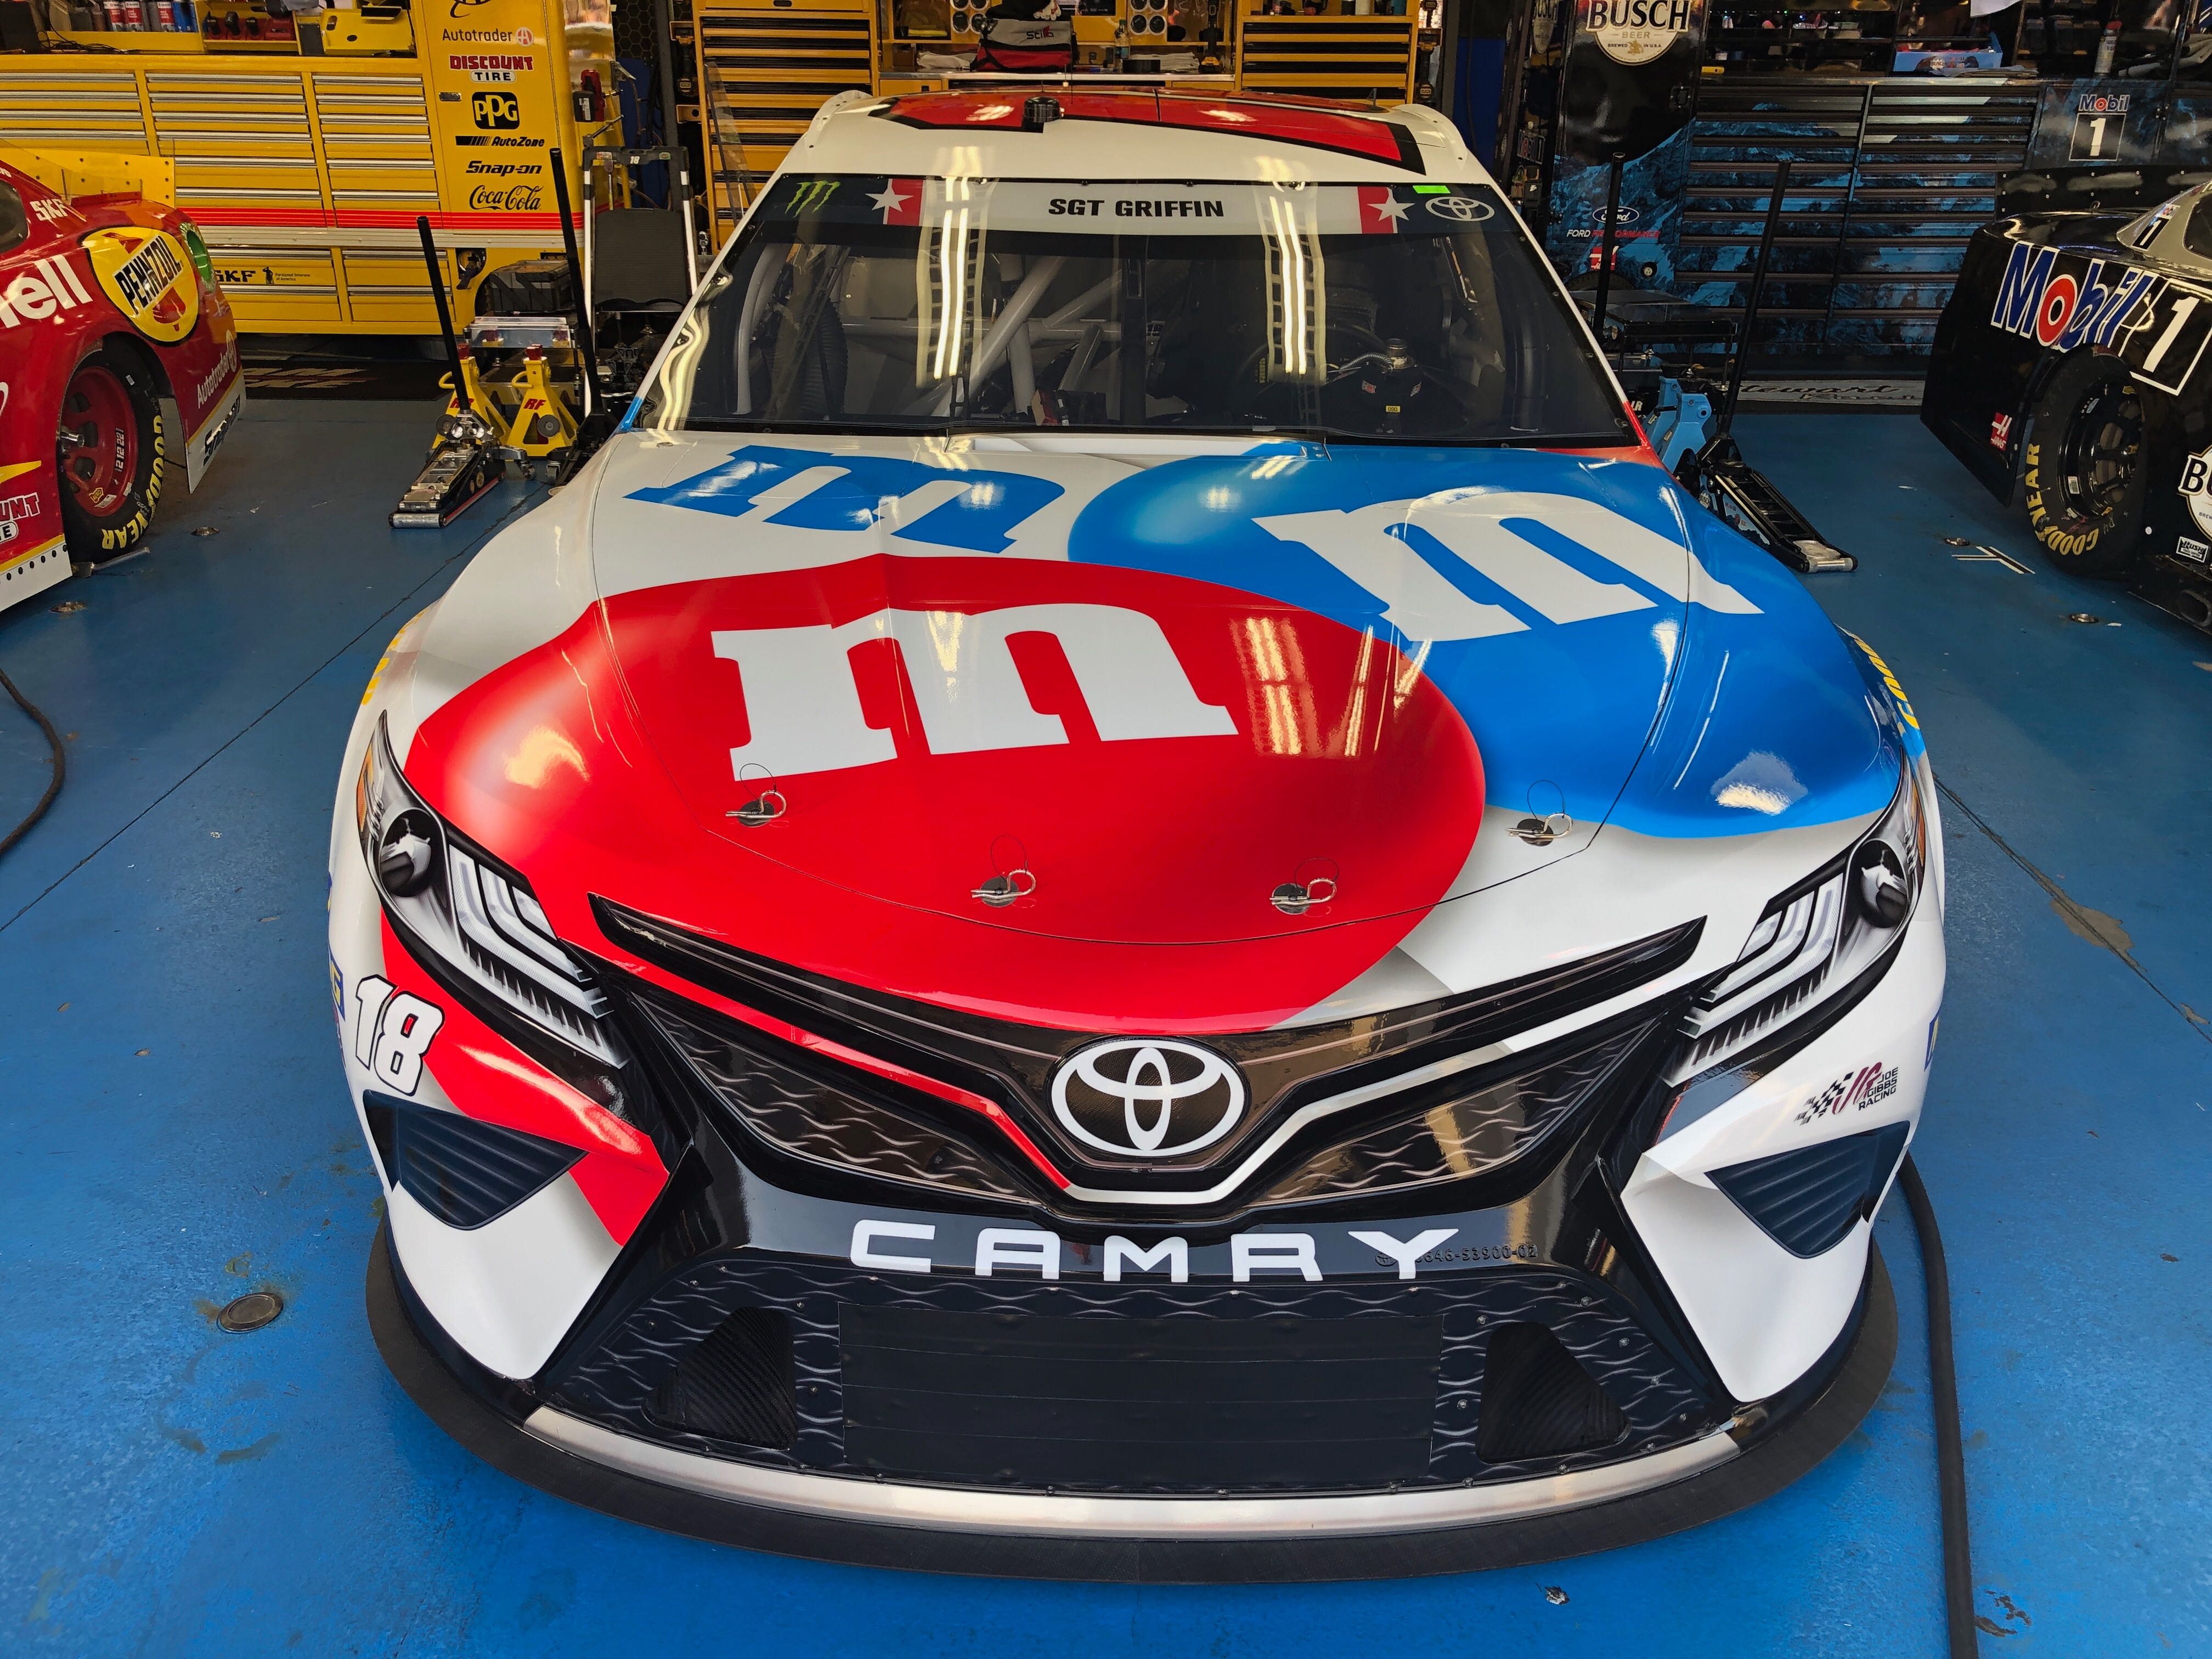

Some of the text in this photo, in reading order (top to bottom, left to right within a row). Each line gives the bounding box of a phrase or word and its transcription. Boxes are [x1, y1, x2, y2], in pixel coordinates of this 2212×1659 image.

[1585, 0, 1689, 31] BUSCH
[442, 28, 512, 42] Autotrader
[449, 55, 534, 70] DISCOUNT
[474, 71, 512, 82] TIRE
[474, 94, 518, 127] PPG
[2078, 94, 2130, 112] Mobil
[491, 136, 545, 147] AutoZone
[2090, 117, 2107, 156] 1
[465, 160, 542, 177] Snap-on
[630, 156, 640, 164] 18
[469, 184, 544, 211] Coca-Cola
[1048, 199, 1224, 217] SGT GRIFFIN
[30, 198, 69, 221] SKF
[1567, 229, 1591, 238] FORD
[114, 235, 183, 316] PENNZOIL
[1991, 241, 2200, 373] Mobil 1
[523, 398, 546, 410] RF
[1251, 492, 1764, 642] m
[711, 602, 1237, 782] m
[356, 974, 445, 1097] 18
[1877, 1067, 1899, 1084] JOE
[1859, 1085, 1897, 1111] RACING
[1867, 1076, 1898, 1098] GIBBS
[850, 1219, 1460, 1283] CAMRY
